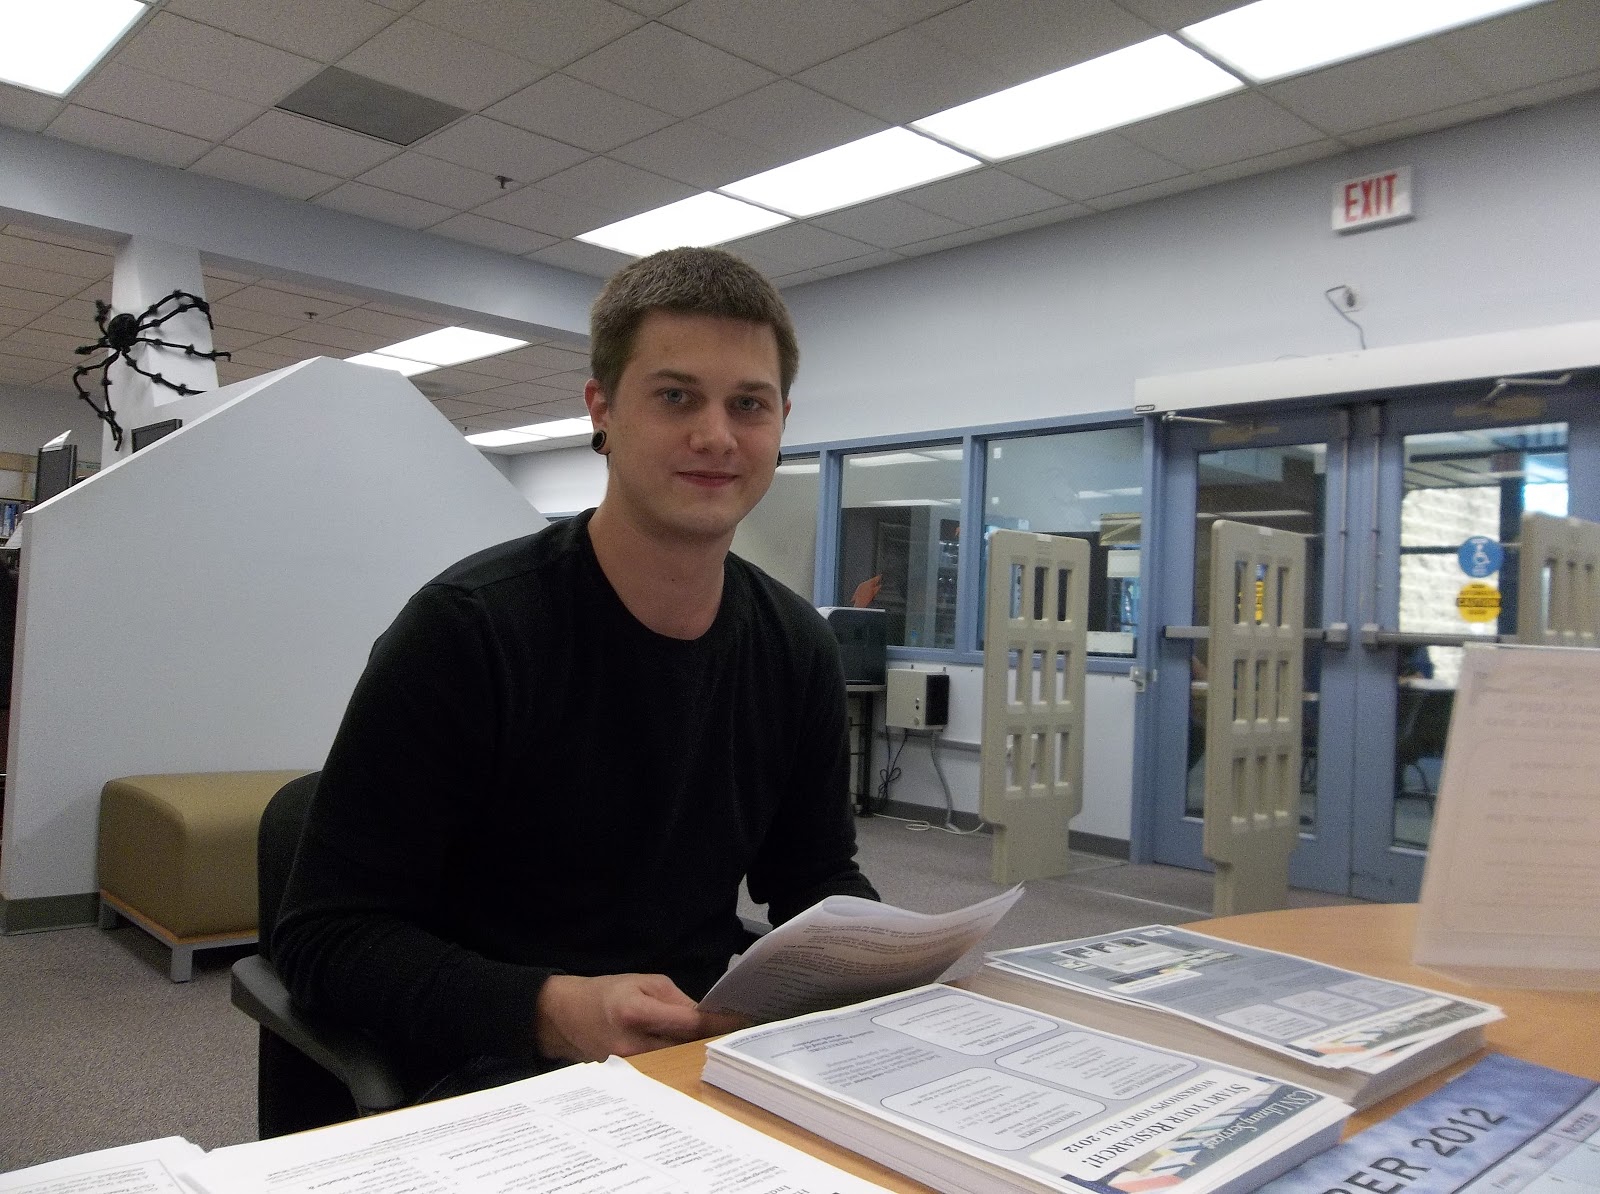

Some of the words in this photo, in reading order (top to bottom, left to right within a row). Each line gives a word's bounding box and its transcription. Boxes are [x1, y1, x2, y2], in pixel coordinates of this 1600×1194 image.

[1345, 172, 1398, 223] EXIT
[1147, 1079, 1220, 1111] WORKSHOPS
[1199, 1083, 1253, 1106] START
[1274, 1089, 1320, 1108] CSN
[1124, 1108, 1157, 1122] FOR
[1162, 1102, 1212, 1124] YOUR
[1235, 1101, 1295, 1127] Library
[1093, 1119, 1137, 1138] FALL
[1196, 1121, 1259, 1151] Services
[1411, 1107, 1509, 1159] 2012
[1059, 1134, 1103, 1153] 2012
[1076, 1121, 1179, 1169] RESEARCH!
